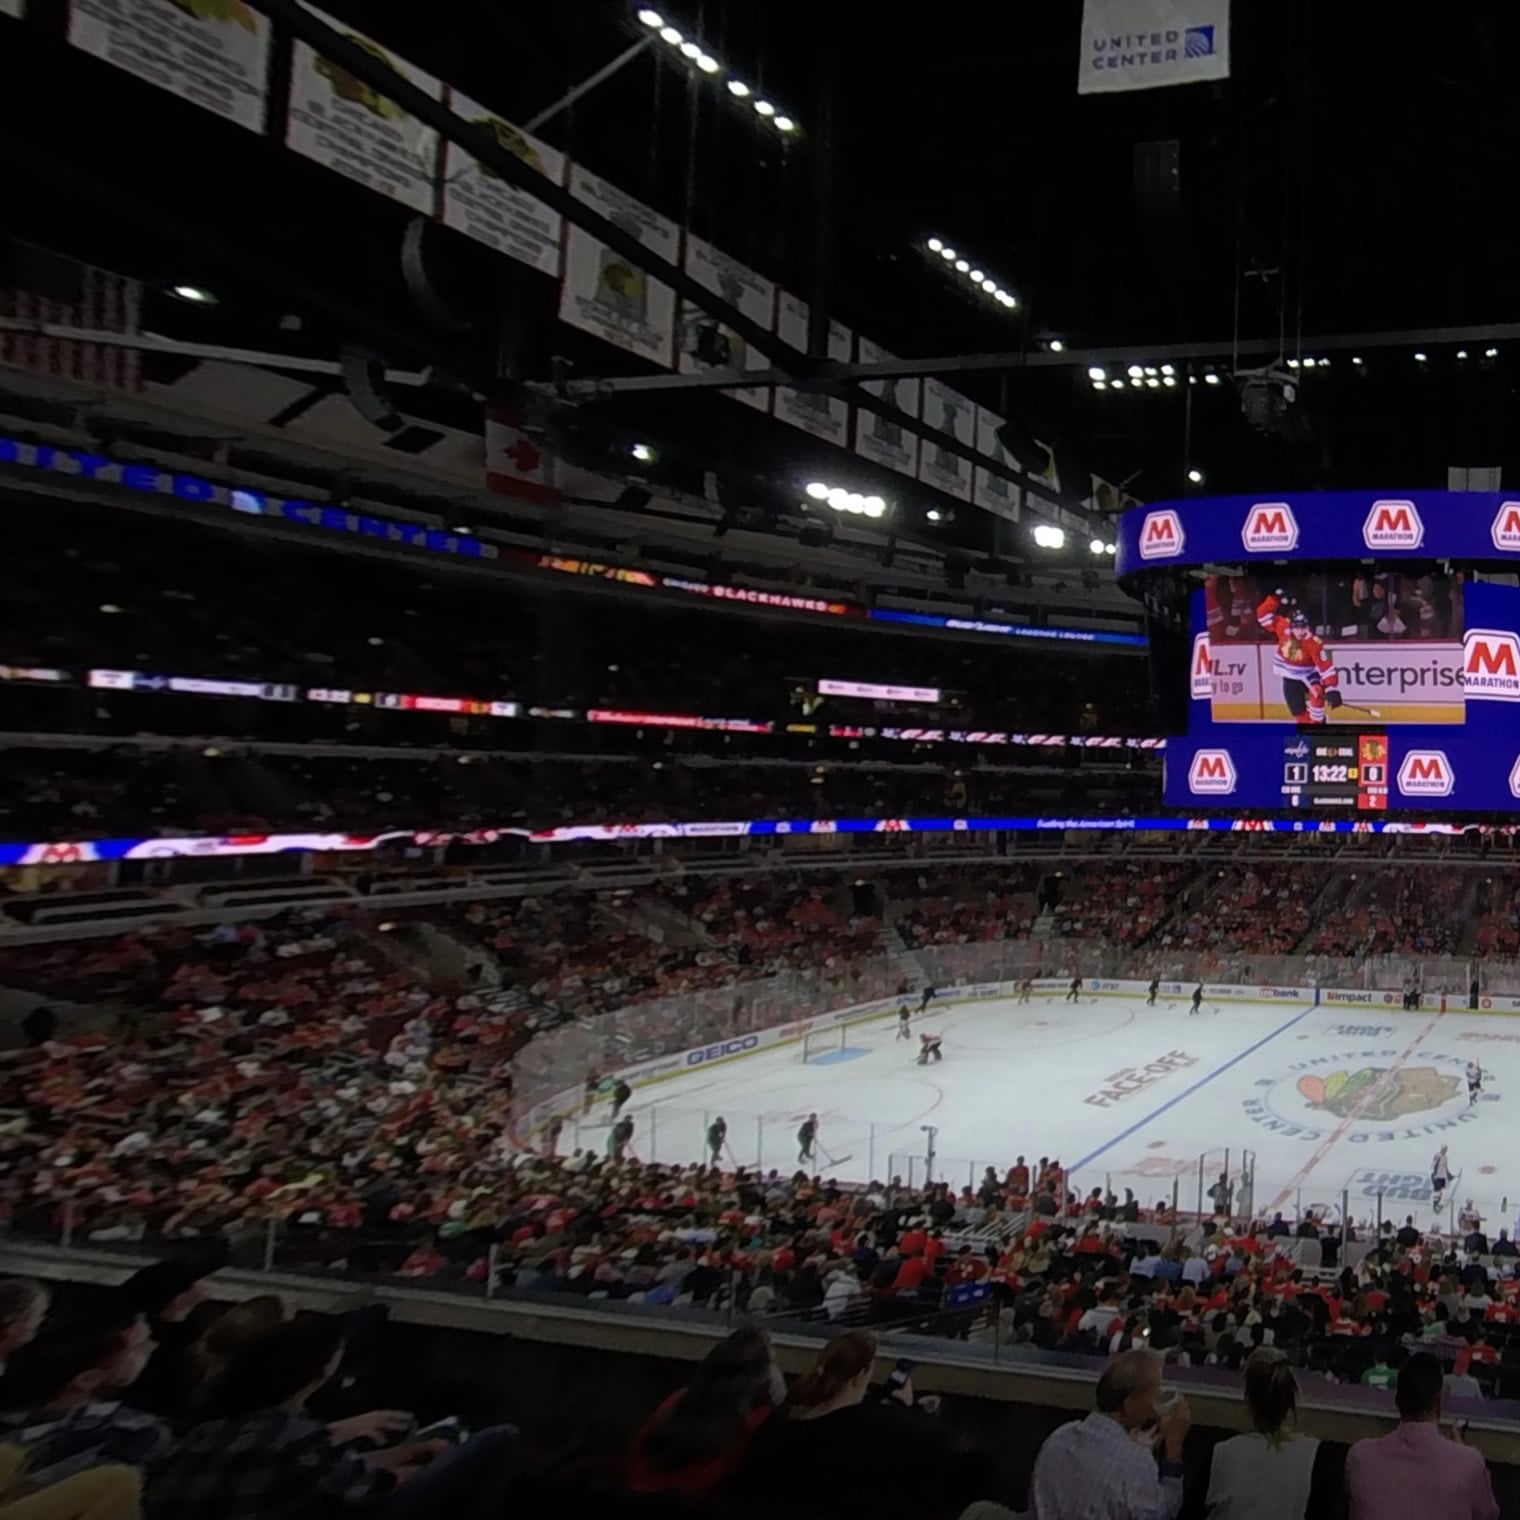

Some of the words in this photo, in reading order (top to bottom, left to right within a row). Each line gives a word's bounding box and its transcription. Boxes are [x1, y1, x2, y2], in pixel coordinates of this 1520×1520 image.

[1093, 30, 1178, 52] UNITED
[1092, 49, 1177, 70] CENTER
[282, 498, 482, 559] CENTER
[1147, 519, 1174, 542] M
[1253, 512, 1287, 534] M
[1375, 509, 1411, 531] M
[1372, 533, 1414, 541] MARATHON
[713, 585, 828, 612] BLACKHAWKS
[1467, 642, 1517, 676] M
[1334, 660, 1465, 693] nterprise
[1464, 678, 1520, 690] MARATHON
[1198, 757, 1226, 777] M
[1293, 766, 1300, 781] 1
[1312, 765, 1347, 782] 13:22
[1369, 766, 1378, 781] 0
[1408, 758, 1443, 779] M
[1369, 795, 1377, 807] 2
[687, 1034, 759, 1066] GEICO
[1083, 1048, 1200, 1108] FACE-OFF
